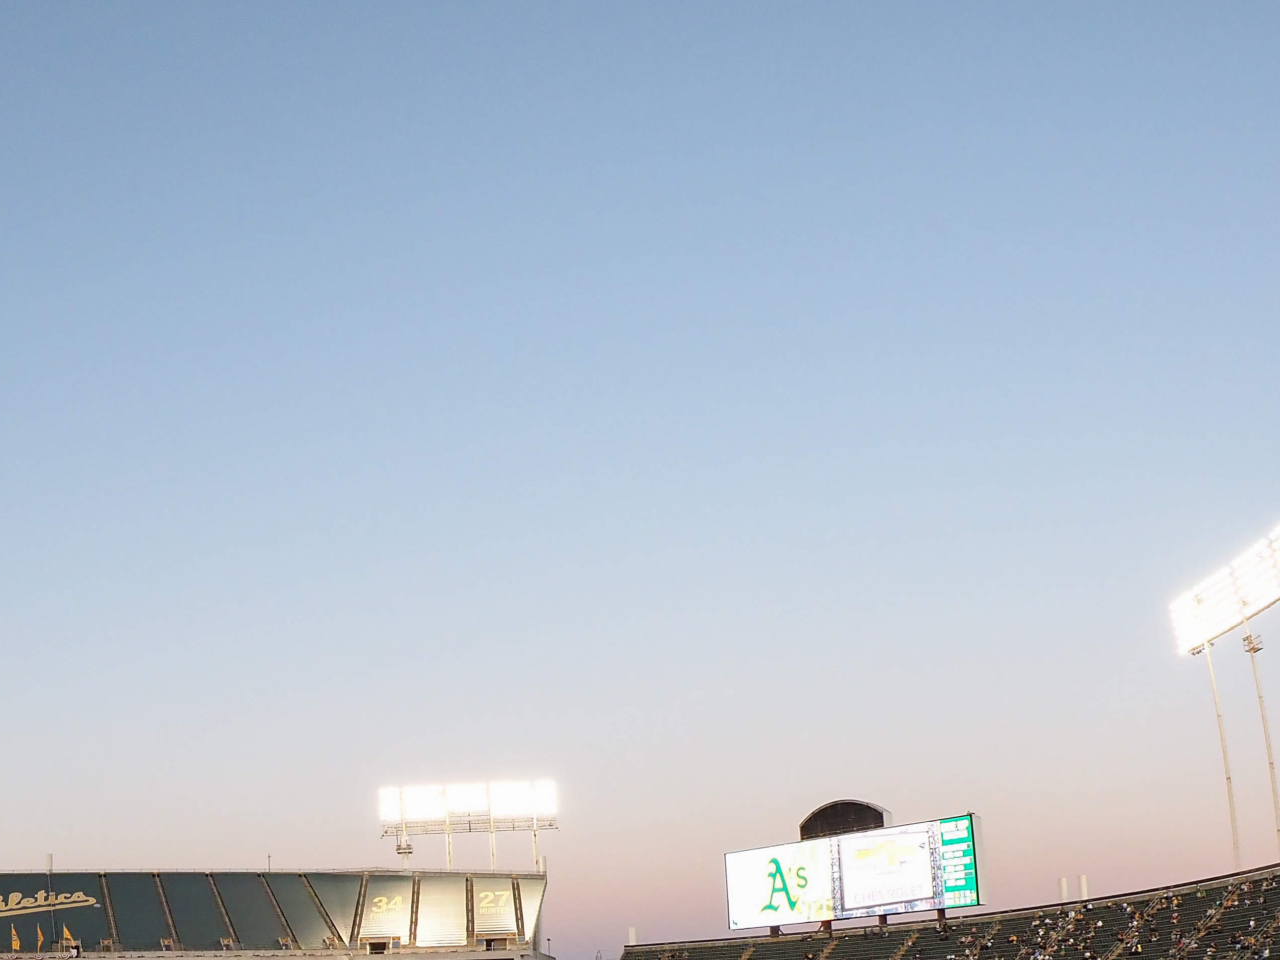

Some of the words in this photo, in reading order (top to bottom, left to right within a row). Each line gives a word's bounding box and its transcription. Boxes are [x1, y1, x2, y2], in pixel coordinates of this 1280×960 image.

[760, 857, 808, 913] A's
[372, 896, 403, 913] 34
[479, 891, 510, 908] 27
